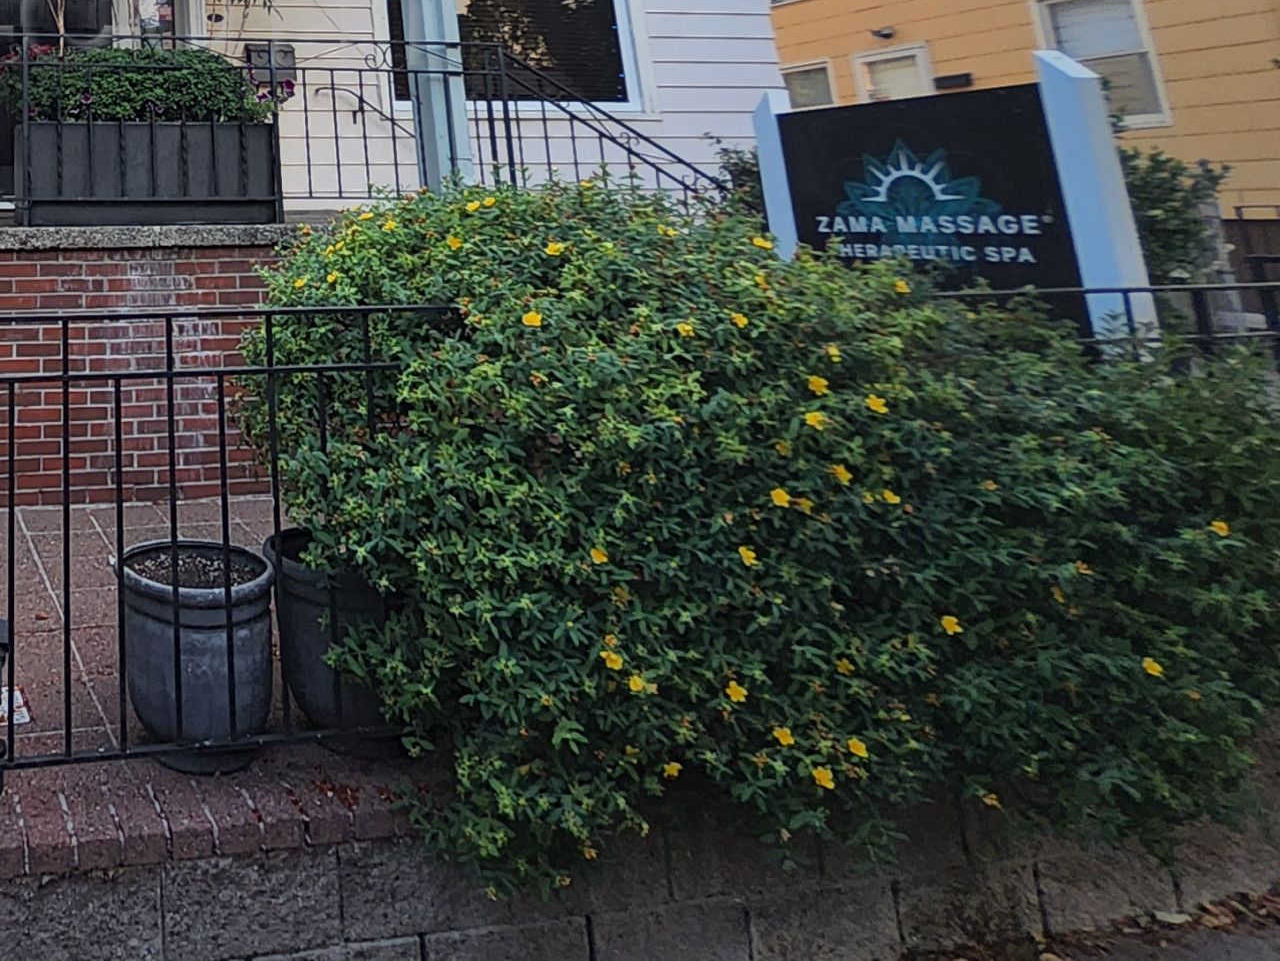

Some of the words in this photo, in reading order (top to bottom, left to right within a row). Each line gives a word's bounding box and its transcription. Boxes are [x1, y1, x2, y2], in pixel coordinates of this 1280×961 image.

[816, 215, 888, 233] ZAMA
[896, 214, 1042, 235] MASSAGE
[837, 243, 978, 261] HERAPEUTIC
[984, 245, 1038, 264] SPA
